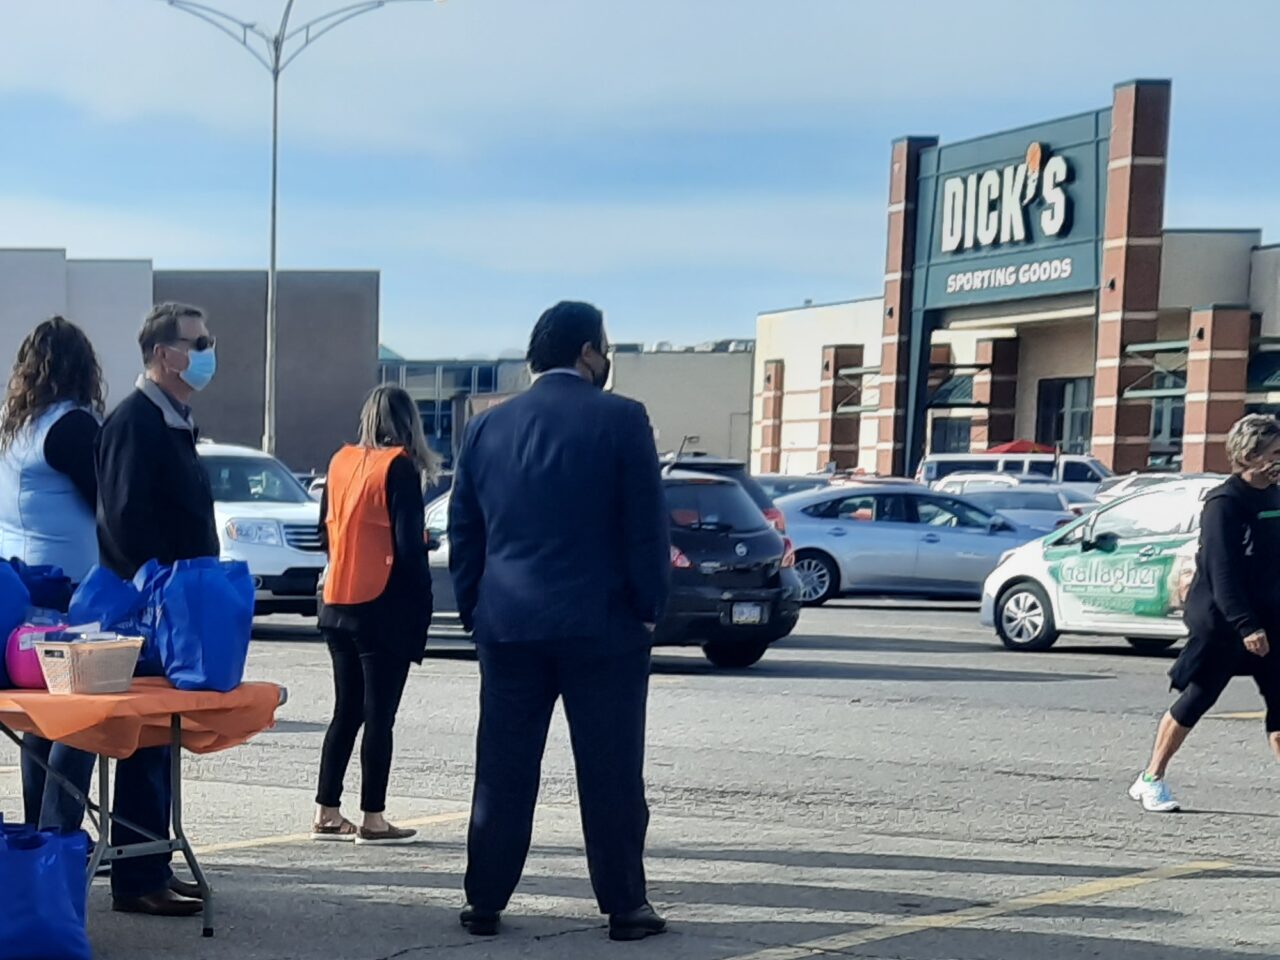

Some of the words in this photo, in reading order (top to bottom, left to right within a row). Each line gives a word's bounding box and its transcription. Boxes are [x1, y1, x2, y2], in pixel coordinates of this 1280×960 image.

[941, 142, 1068, 253] DICK'S
[946, 265, 1017, 294] SPORTING
[1018, 257, 1072, 284] GOODS
[1058, 559, 1162, 594] Gallagher
